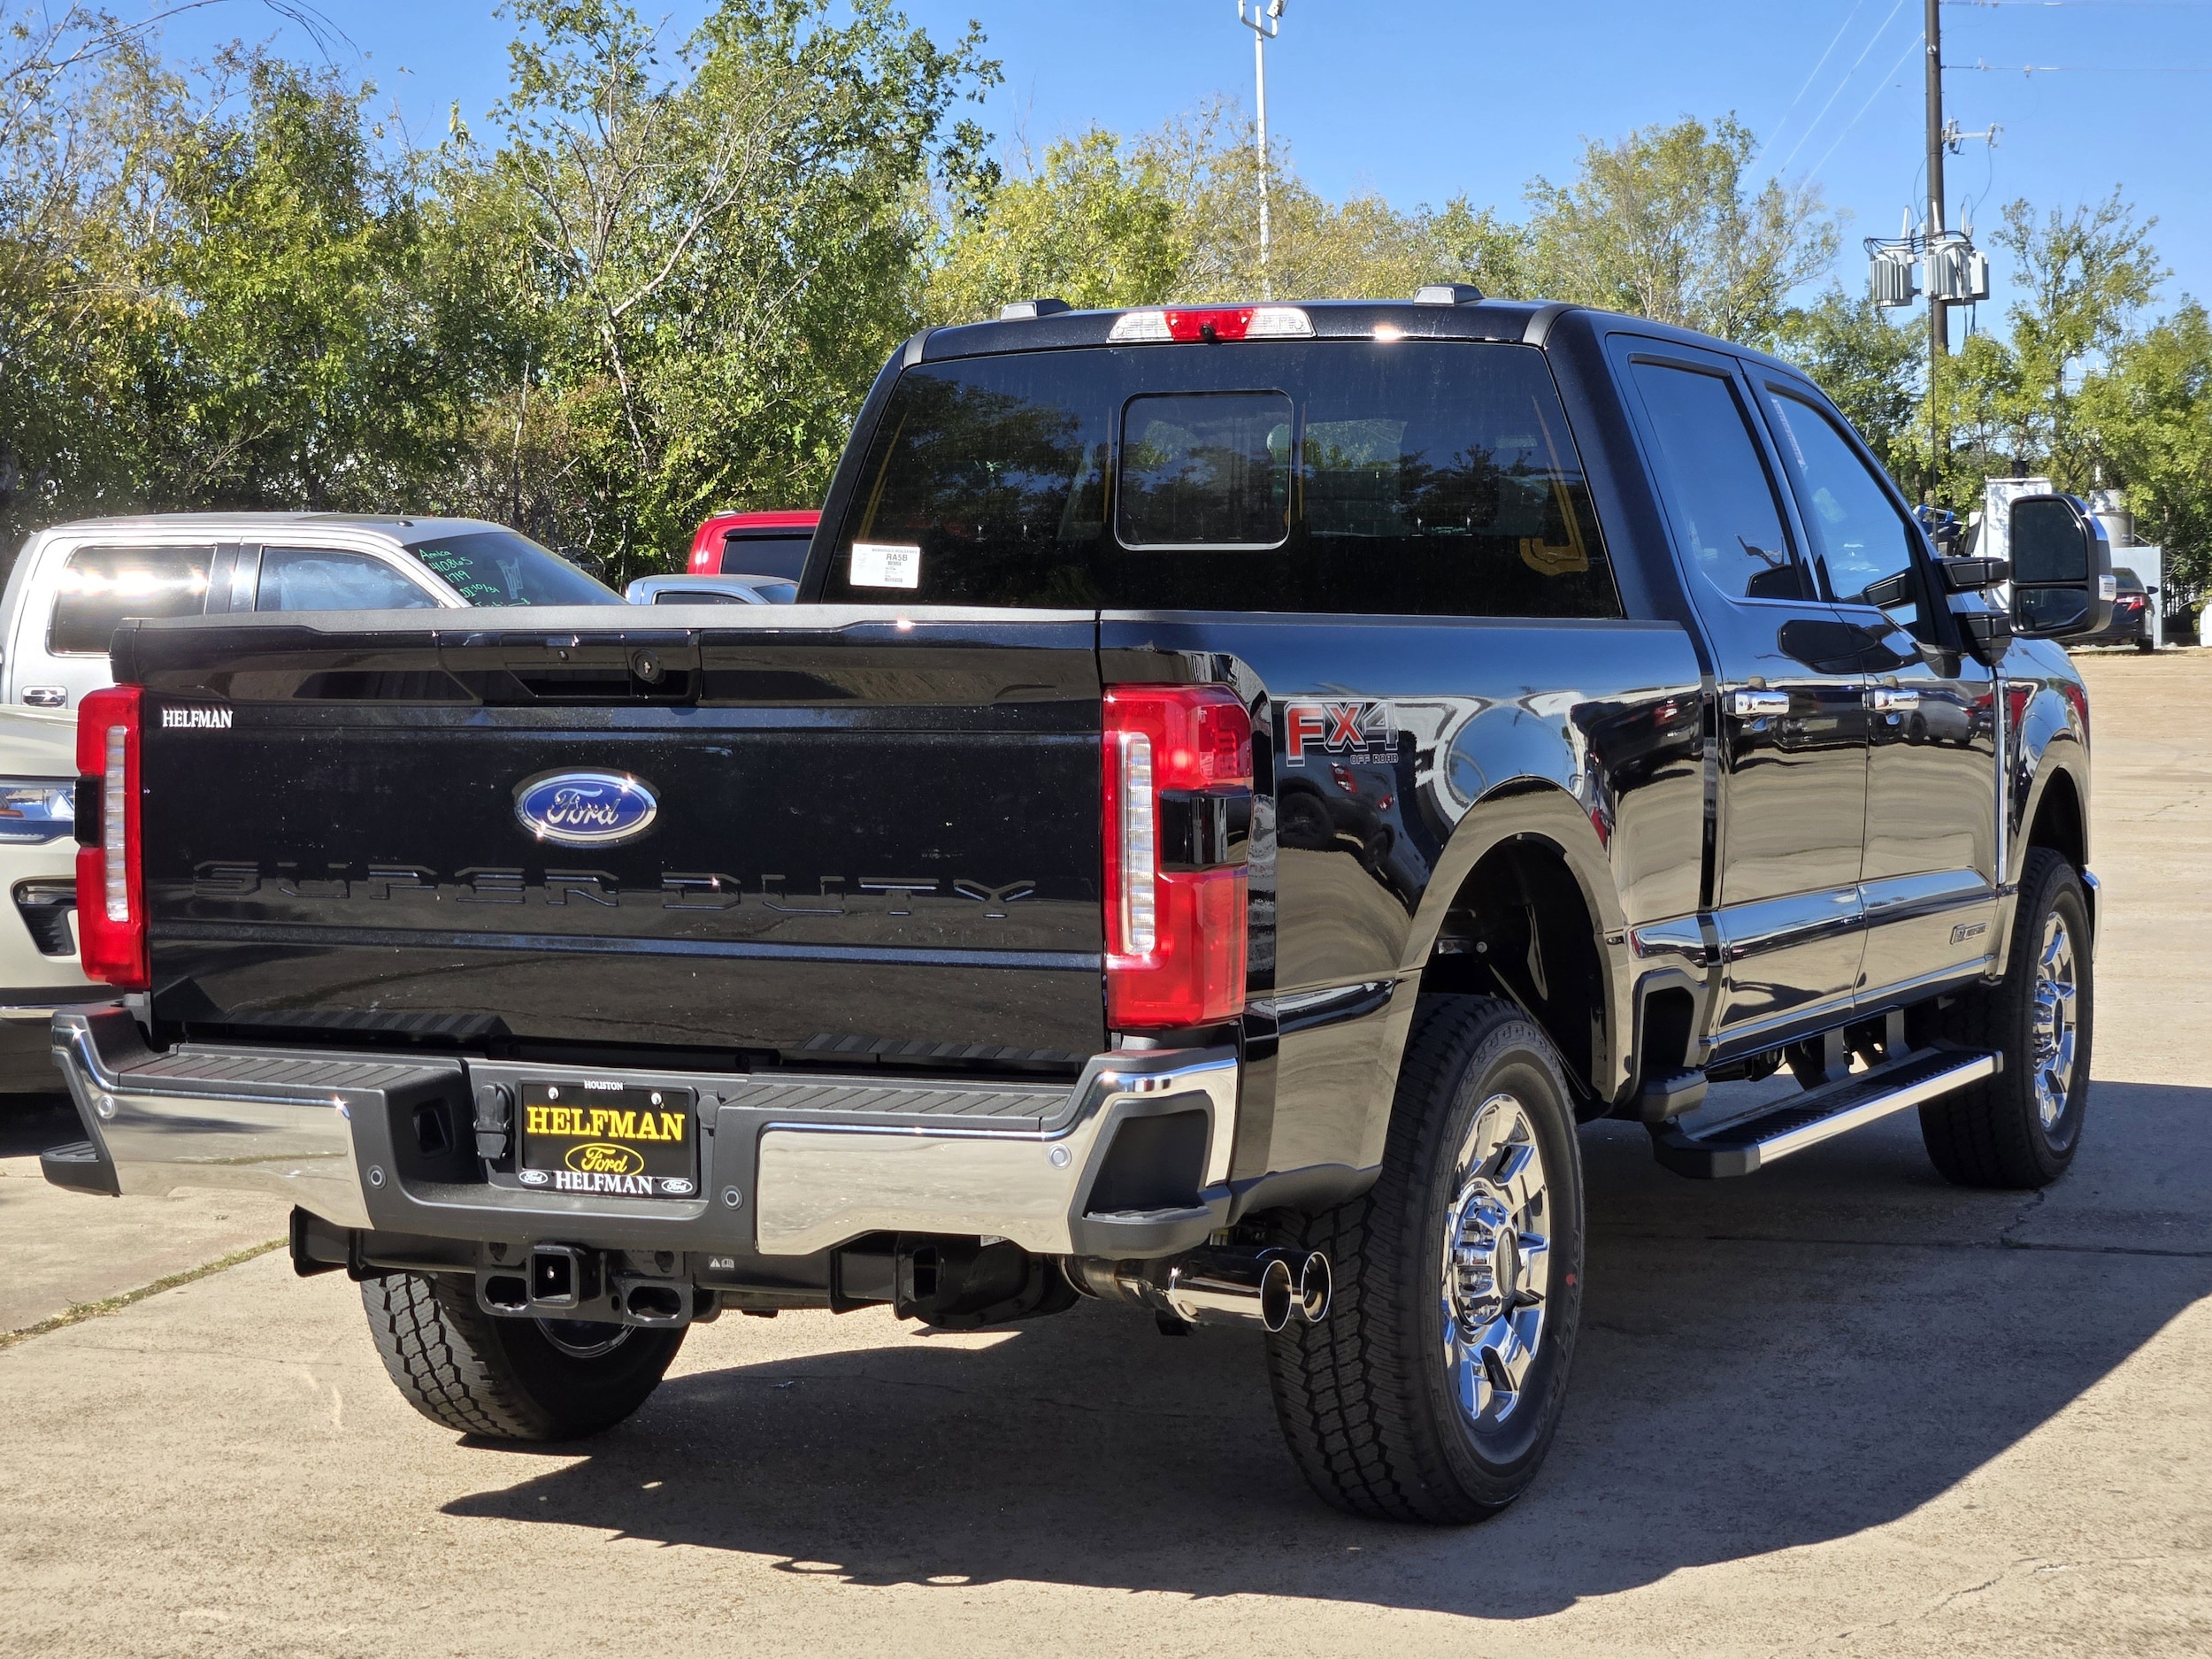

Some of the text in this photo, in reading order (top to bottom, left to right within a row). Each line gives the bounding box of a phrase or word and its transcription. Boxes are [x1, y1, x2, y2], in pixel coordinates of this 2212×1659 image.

[444, 570, 472, 584] 1719
[162, 709, 234, 728] HELFMAN
[1284, 700, 1399, 768] FX4
[1350, 753, 1399, 764] OFF ROAD
[546, 787, 621, 826] Ford
[192, 860, 1036, 919] SUPER DUTY
[584, 1079, 625, 1091] HOUSTON
[526, 1106, 686, 1141] HELFMAN
[580, 1147, 628, 1173] Ford
[555, 1171, 654, 1195] HELFMAN
